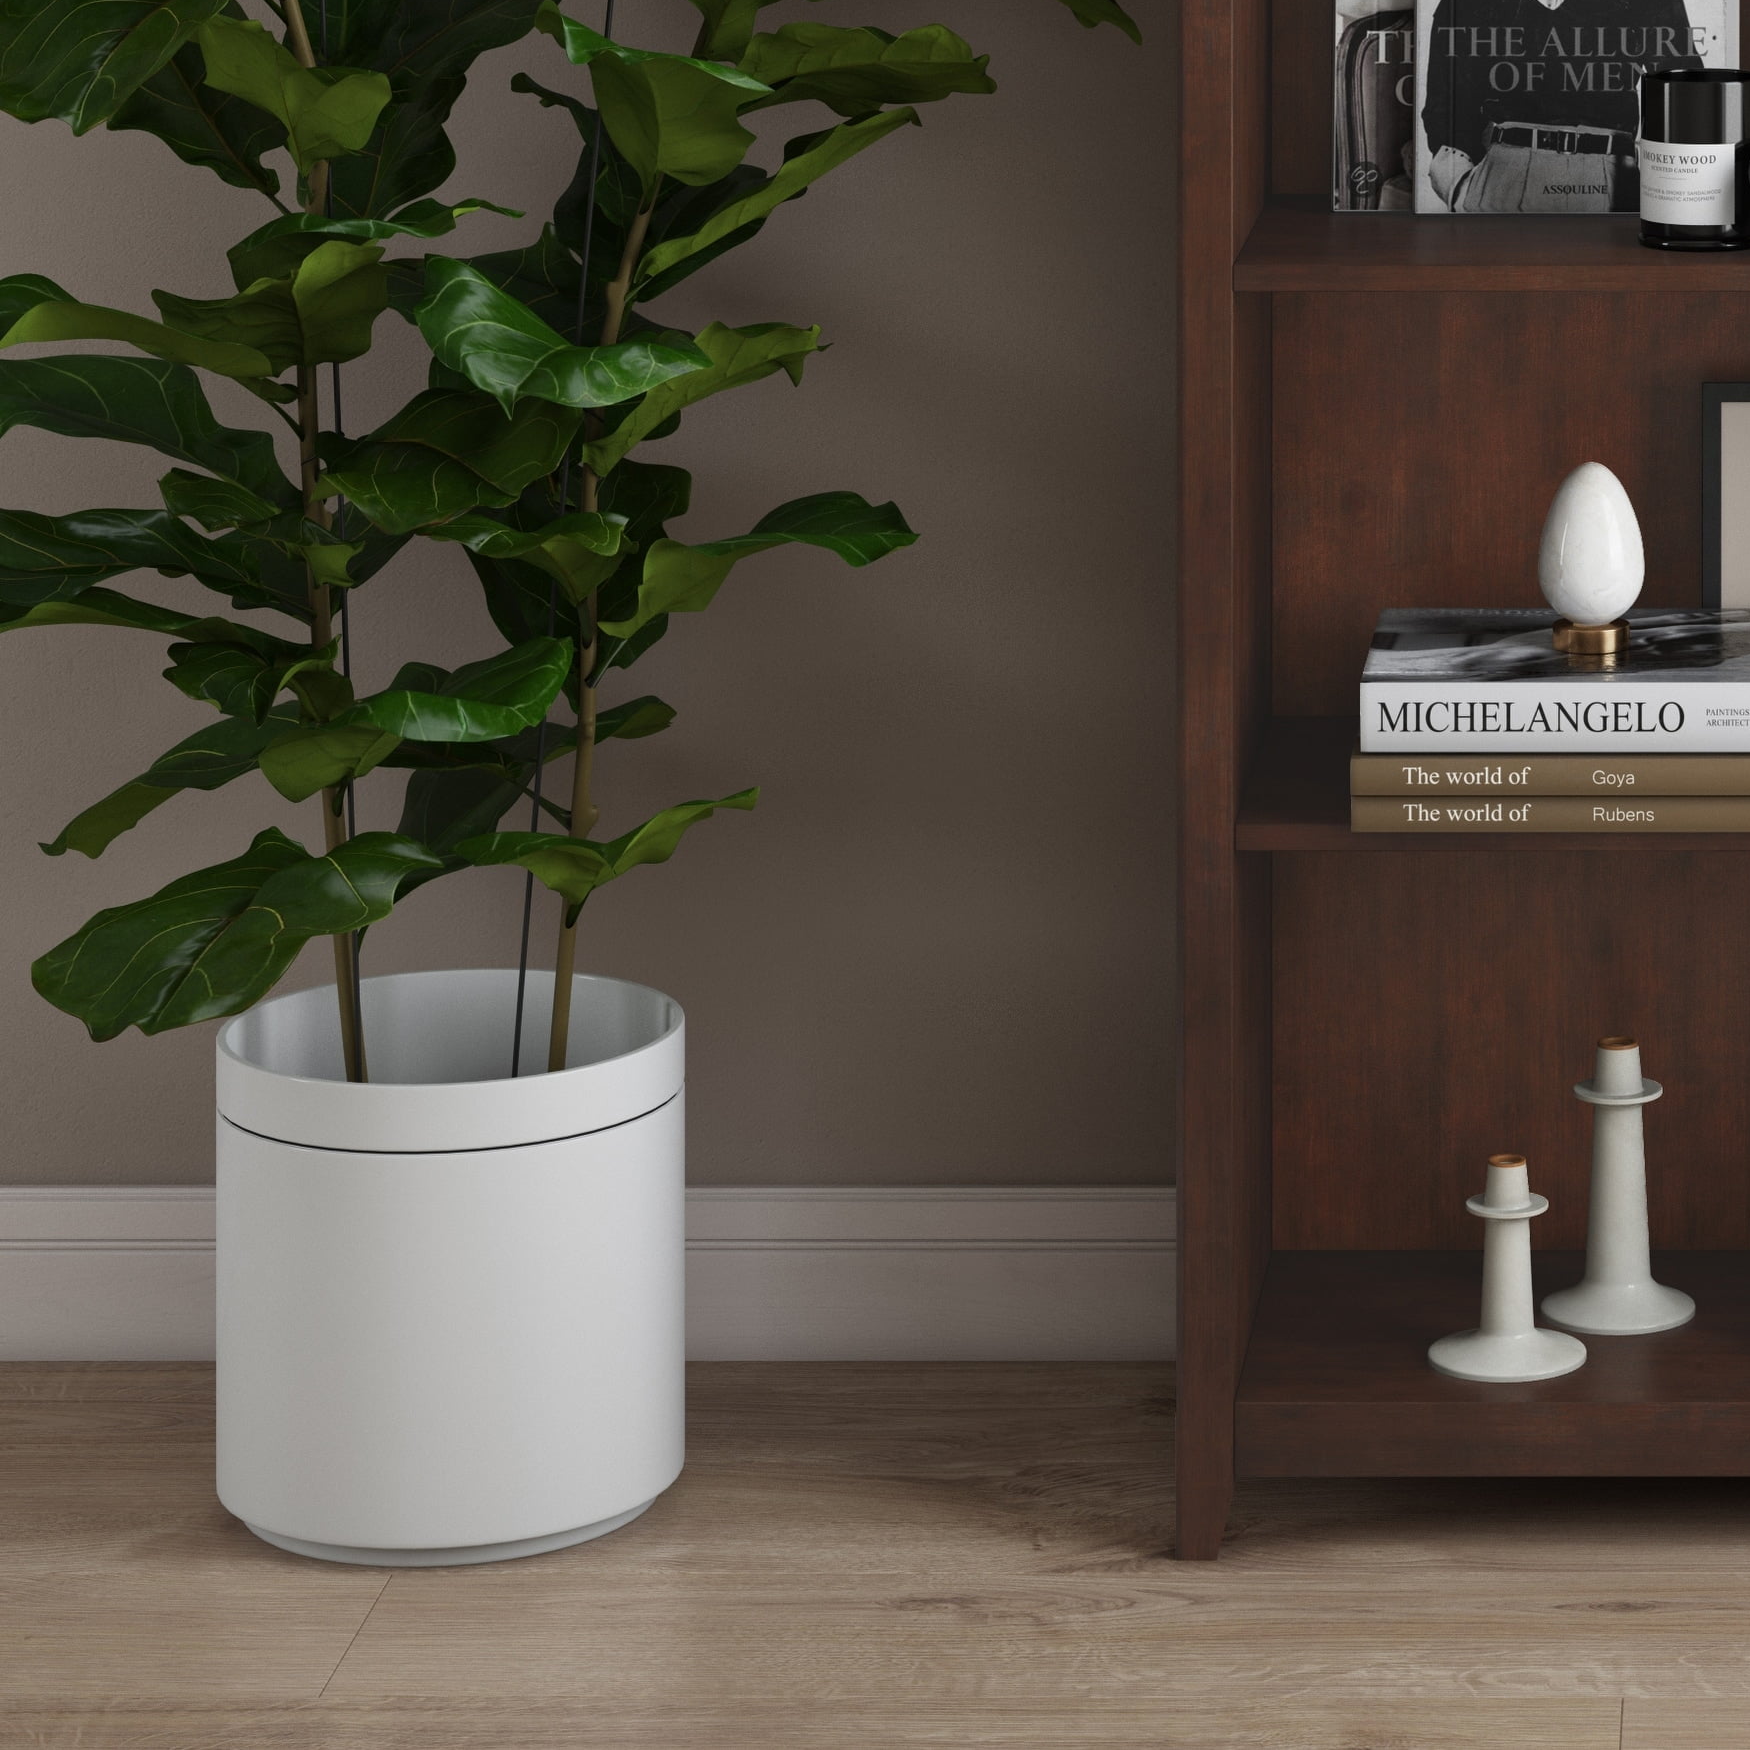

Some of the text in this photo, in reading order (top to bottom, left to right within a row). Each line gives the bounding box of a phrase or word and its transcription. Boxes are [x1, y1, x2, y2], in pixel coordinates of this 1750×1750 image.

[1437, 26, 1527, 57] THE
[1539, 26, 1709, 57] ALLURE
[1489, 62, 1546, 92] OF
[1679, 155, 1717, 165] WOOD
[1543, 185, 1608, 195] ASSOULINE
[1378, 702, 1684, 732] MICHELANGELO
[1403, 767, 1634, 787] The world of Goya
[1403, 804, 1654, 821] The world of Rubens
